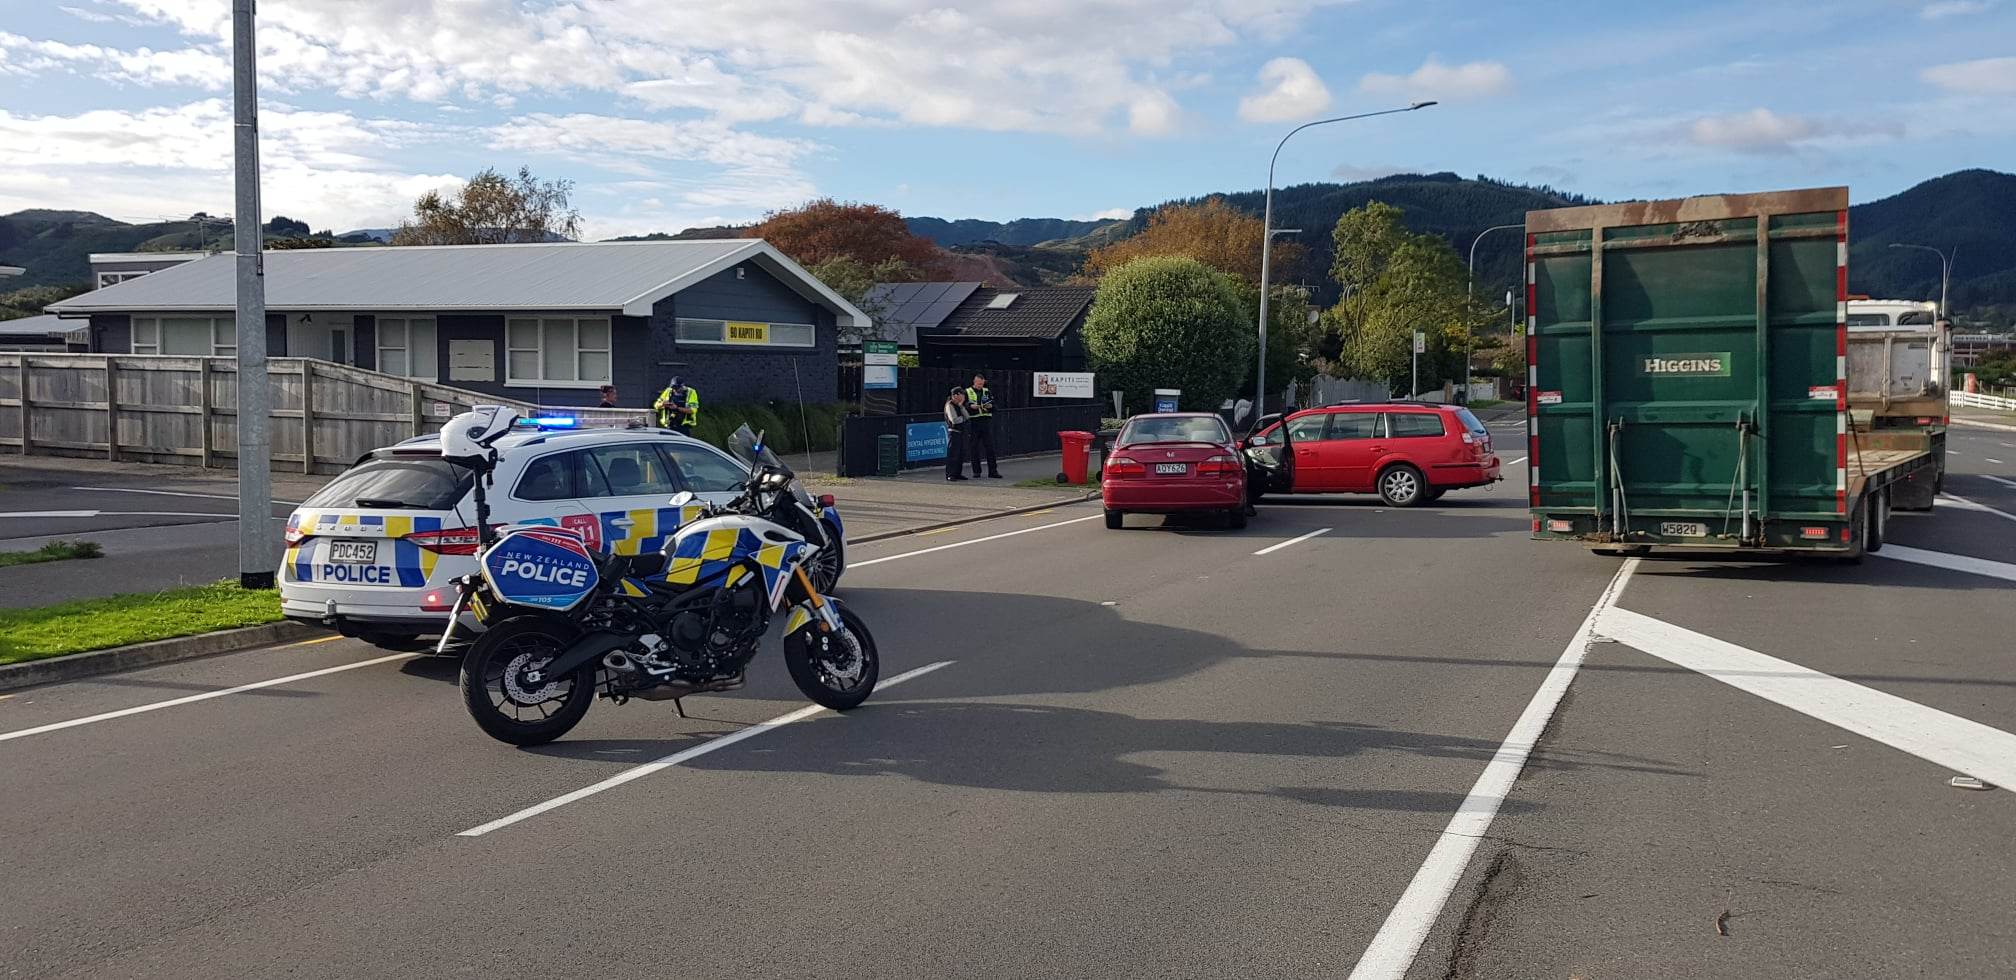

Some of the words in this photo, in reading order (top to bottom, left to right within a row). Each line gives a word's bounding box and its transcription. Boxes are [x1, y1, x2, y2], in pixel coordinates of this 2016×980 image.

[738, 327, 755, 339] KAPITI
[1645, 358, 1721, 373] HIGGINS
[908, 440, 923, 448] DENTAL
[924, 439, 941, 447] HYGIENE
[332, 544, 374, 559] PDC452
[506, 551, 532, 560] NEW
[536, 555, 590, 570] ZEALAND
[323, 564, 391, 583] POLICE
[501, 560, 588, 587] POLICE
